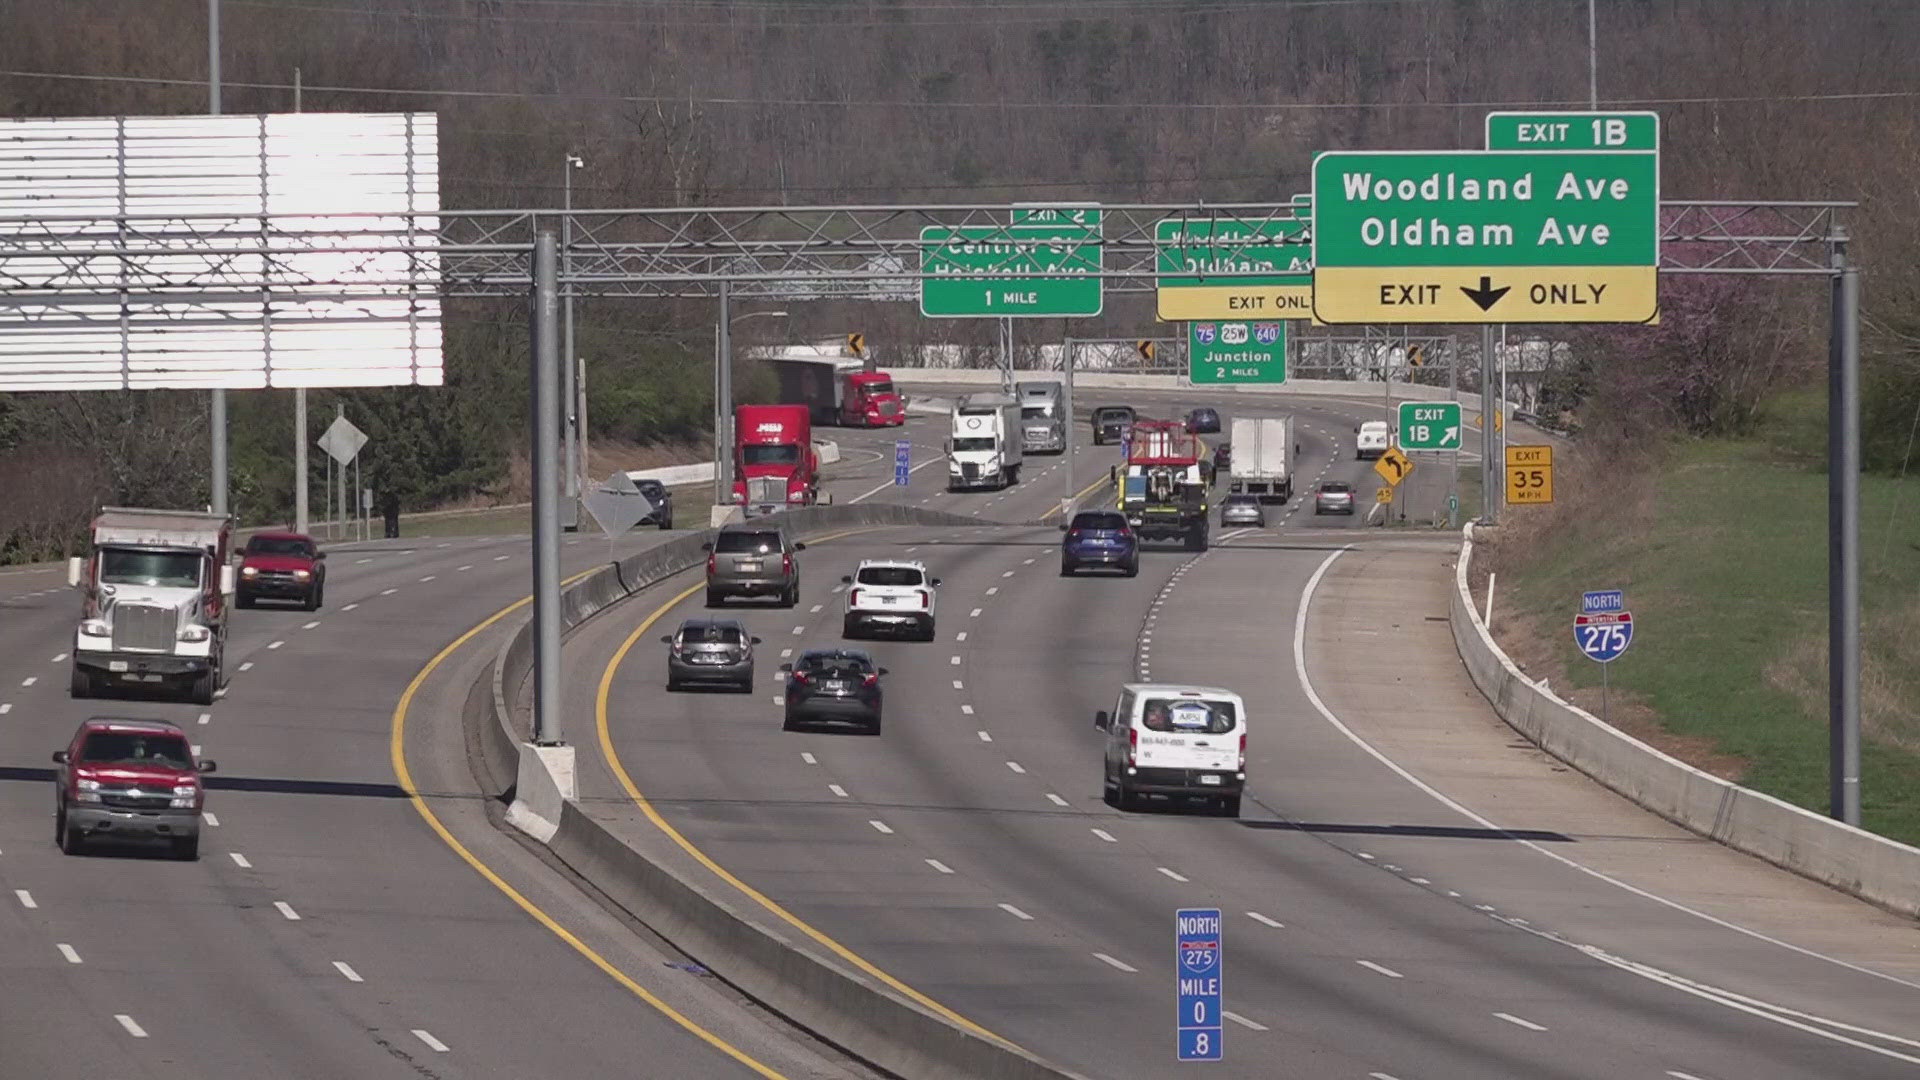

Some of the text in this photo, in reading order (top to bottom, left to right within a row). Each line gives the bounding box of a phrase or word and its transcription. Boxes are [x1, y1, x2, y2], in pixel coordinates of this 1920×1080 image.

[1518, 119, 1627, 146] EXIT 1B
[1343, 172, 1629, 201] Woodland Ave
[1073, 208, 1085, 223] 2
[1361, 217, 1611, 246] Oldham Ave
[948, 237, 1075, 254] Central St
[1044, 264, 1087, 281] Ave
[1185, 257, 1273, 273] Oldham
[985, 290, 1037, 306] 1 MILE
[1229, 295, 1312, 309] EXIT ONL
[1380, 284, 1607, 305] EXIT ONLY
[1198, 327, 1215, 340] 75
[1223, 327, 1247, 340] 25W
[1256, 327, 1277, 340] 640
[1204, 351, 1271, 363] Junction
[1216, 368, 1260, 378] 2 MILES
[1415, 409, 1445, 421] EXIT
[1409, 425, 1430, 442] 1B
[1515, 451, 1541, 461] EXIT
[1514, 471, 1544, 488] 35
[1518, 491, 1542, 500] MPH
[1584, 594, 1621, 609] NORTH
[1583, 624, 1626, 652] 275
[1179, 917, 1219, 935] NORTH
[1186, 950, 1212, 965] 275
[1180, 978, 1218, 996] MILE
[1194, 1001, 1206, 1024] 0
[1191, 1032, 1209, 1055] .8
